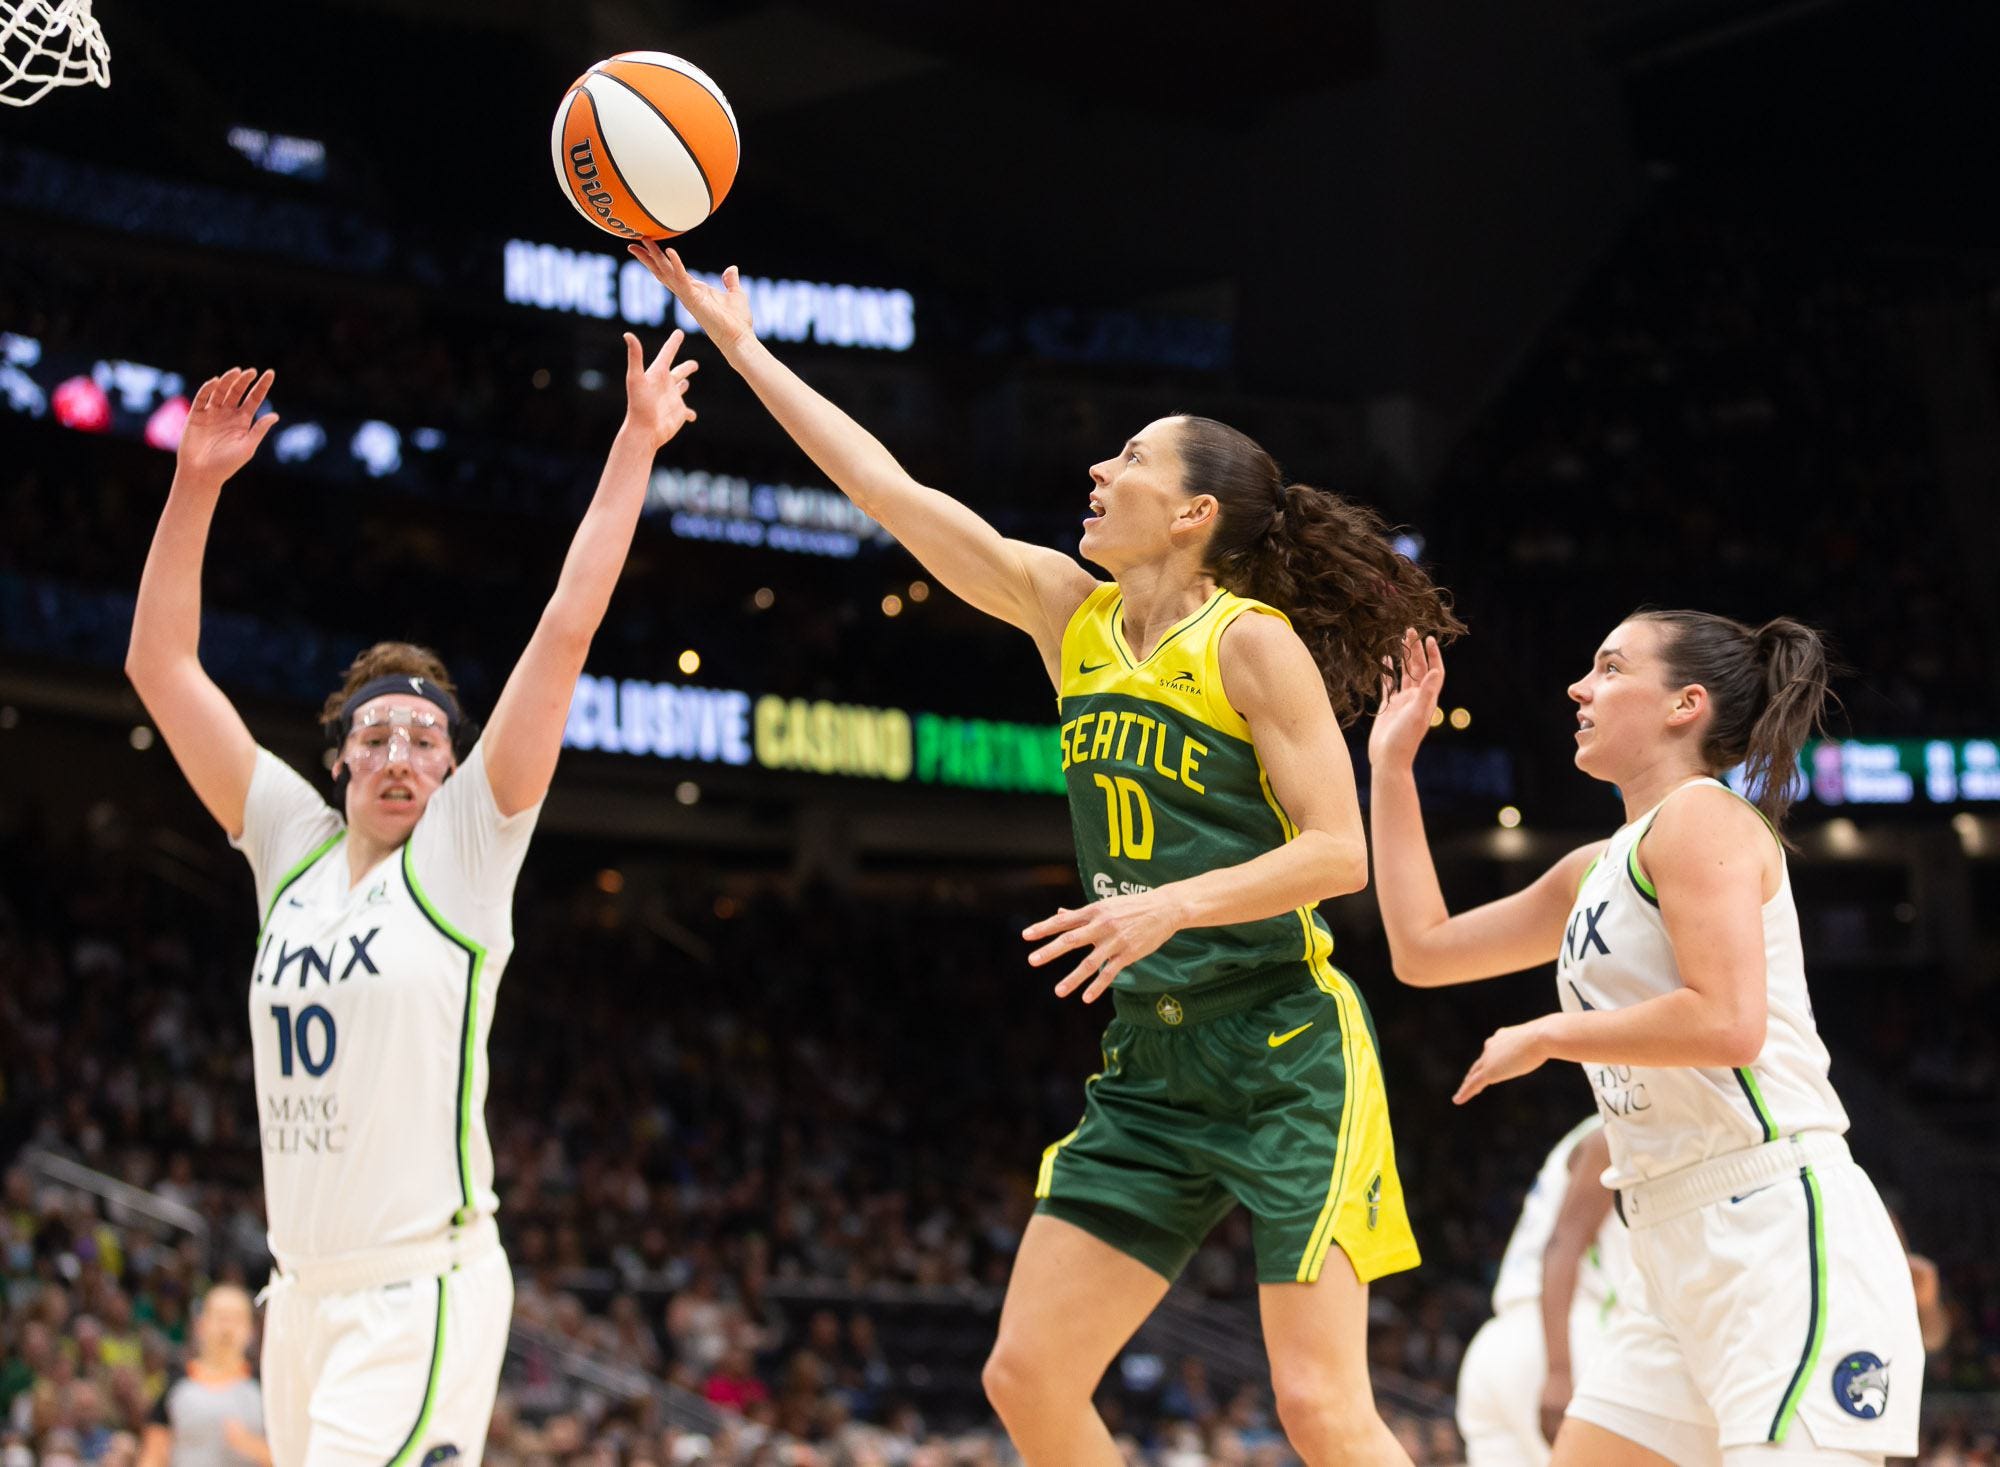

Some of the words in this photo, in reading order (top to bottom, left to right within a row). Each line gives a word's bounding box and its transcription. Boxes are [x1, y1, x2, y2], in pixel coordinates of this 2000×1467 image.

[570, 137, 644, 238] Wilson
[503, 238, 618, 319] HOME
[674, 268, 916, 352] MPIONS
[561, 672, 752, 766] CLUSIVE
[753, 694, 914, 782] CASINO
[1159, 678, 1202, 696] SYMETRA
[1060, 711, 1209, 796] SEATTLE
[1093, 773, 1155, 860] 10
[1563, 900, 1612, 969] NX
[271, 1004, 337, 1078] 10
[1601, 1083, 1652, 1117] NIC
